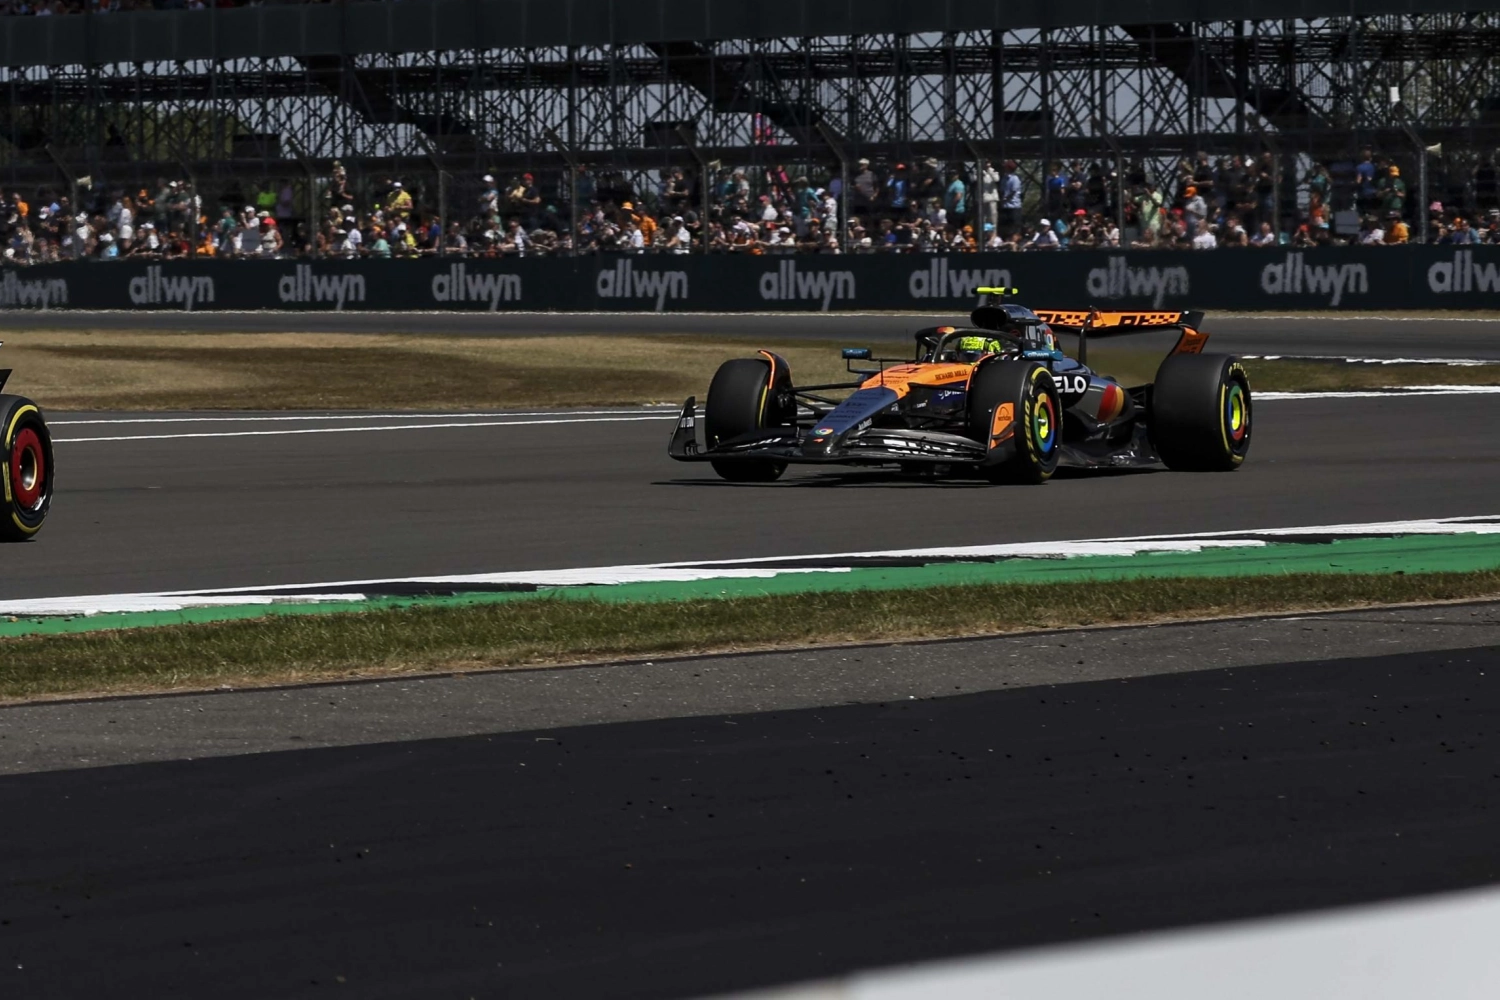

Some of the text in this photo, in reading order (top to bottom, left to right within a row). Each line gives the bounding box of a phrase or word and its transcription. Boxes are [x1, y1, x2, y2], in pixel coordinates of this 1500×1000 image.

[129, 265, 214, 311] allwyn
[279, 264, 364, 311] allwyn
[432, 263, 521, 311] allwyn
[598, 258, 688, 312] allwyn
[760, 260, 855, 312] allwyn
[909, 257, 1011, 307] allwyn
[1087, 256, 1189, 308] allwyn
[1261, 252, 1368, 306] allwyn
[1427, 250, 1500, 293] allw
[1052, 376, 1087, 393] ELO
